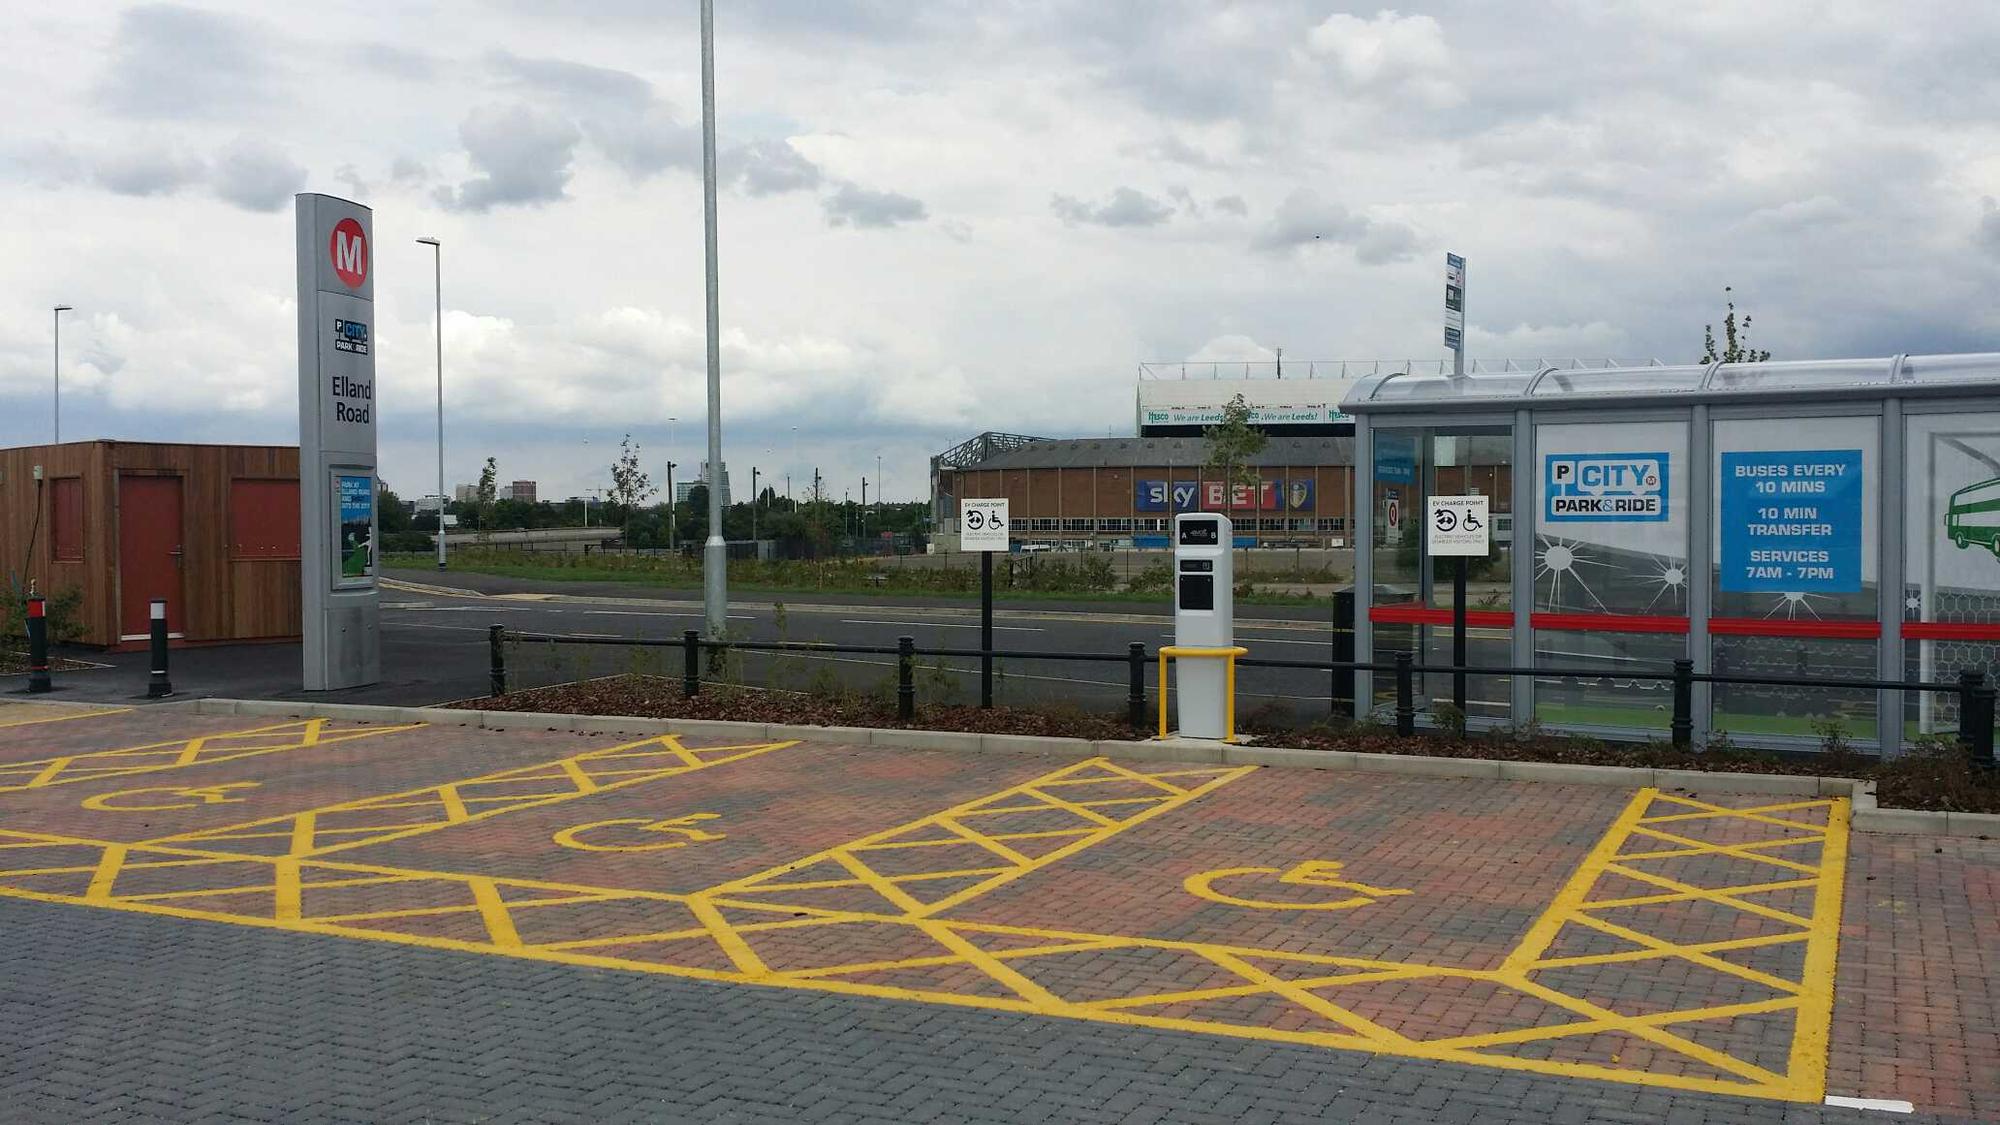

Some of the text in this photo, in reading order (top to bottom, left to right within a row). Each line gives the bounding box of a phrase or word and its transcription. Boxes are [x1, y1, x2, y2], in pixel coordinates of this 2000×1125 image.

[336, 231, 363, 275] M
[332, 376, 371, 400] Elland
[336, 401, 370, 424] Road
[1557, 465, 1570, 479] P
[1582, 465, 1650, 486] CITY
[1735, 464, 1846, 477] BUSES EVERY
[1756, 481, 1826, 493] 10 MINS
[1150, 482, 1269, 507] sky BET
[1758, 507, 1817, 519] 10 MIN
[1748, 524, 1832, 535] TRANSFER
[1750, 551, 1829, 562] SERVICES
[1746, 567, 1782, 578] 7AM
[1797, 567, 1834, 579] 7PM
